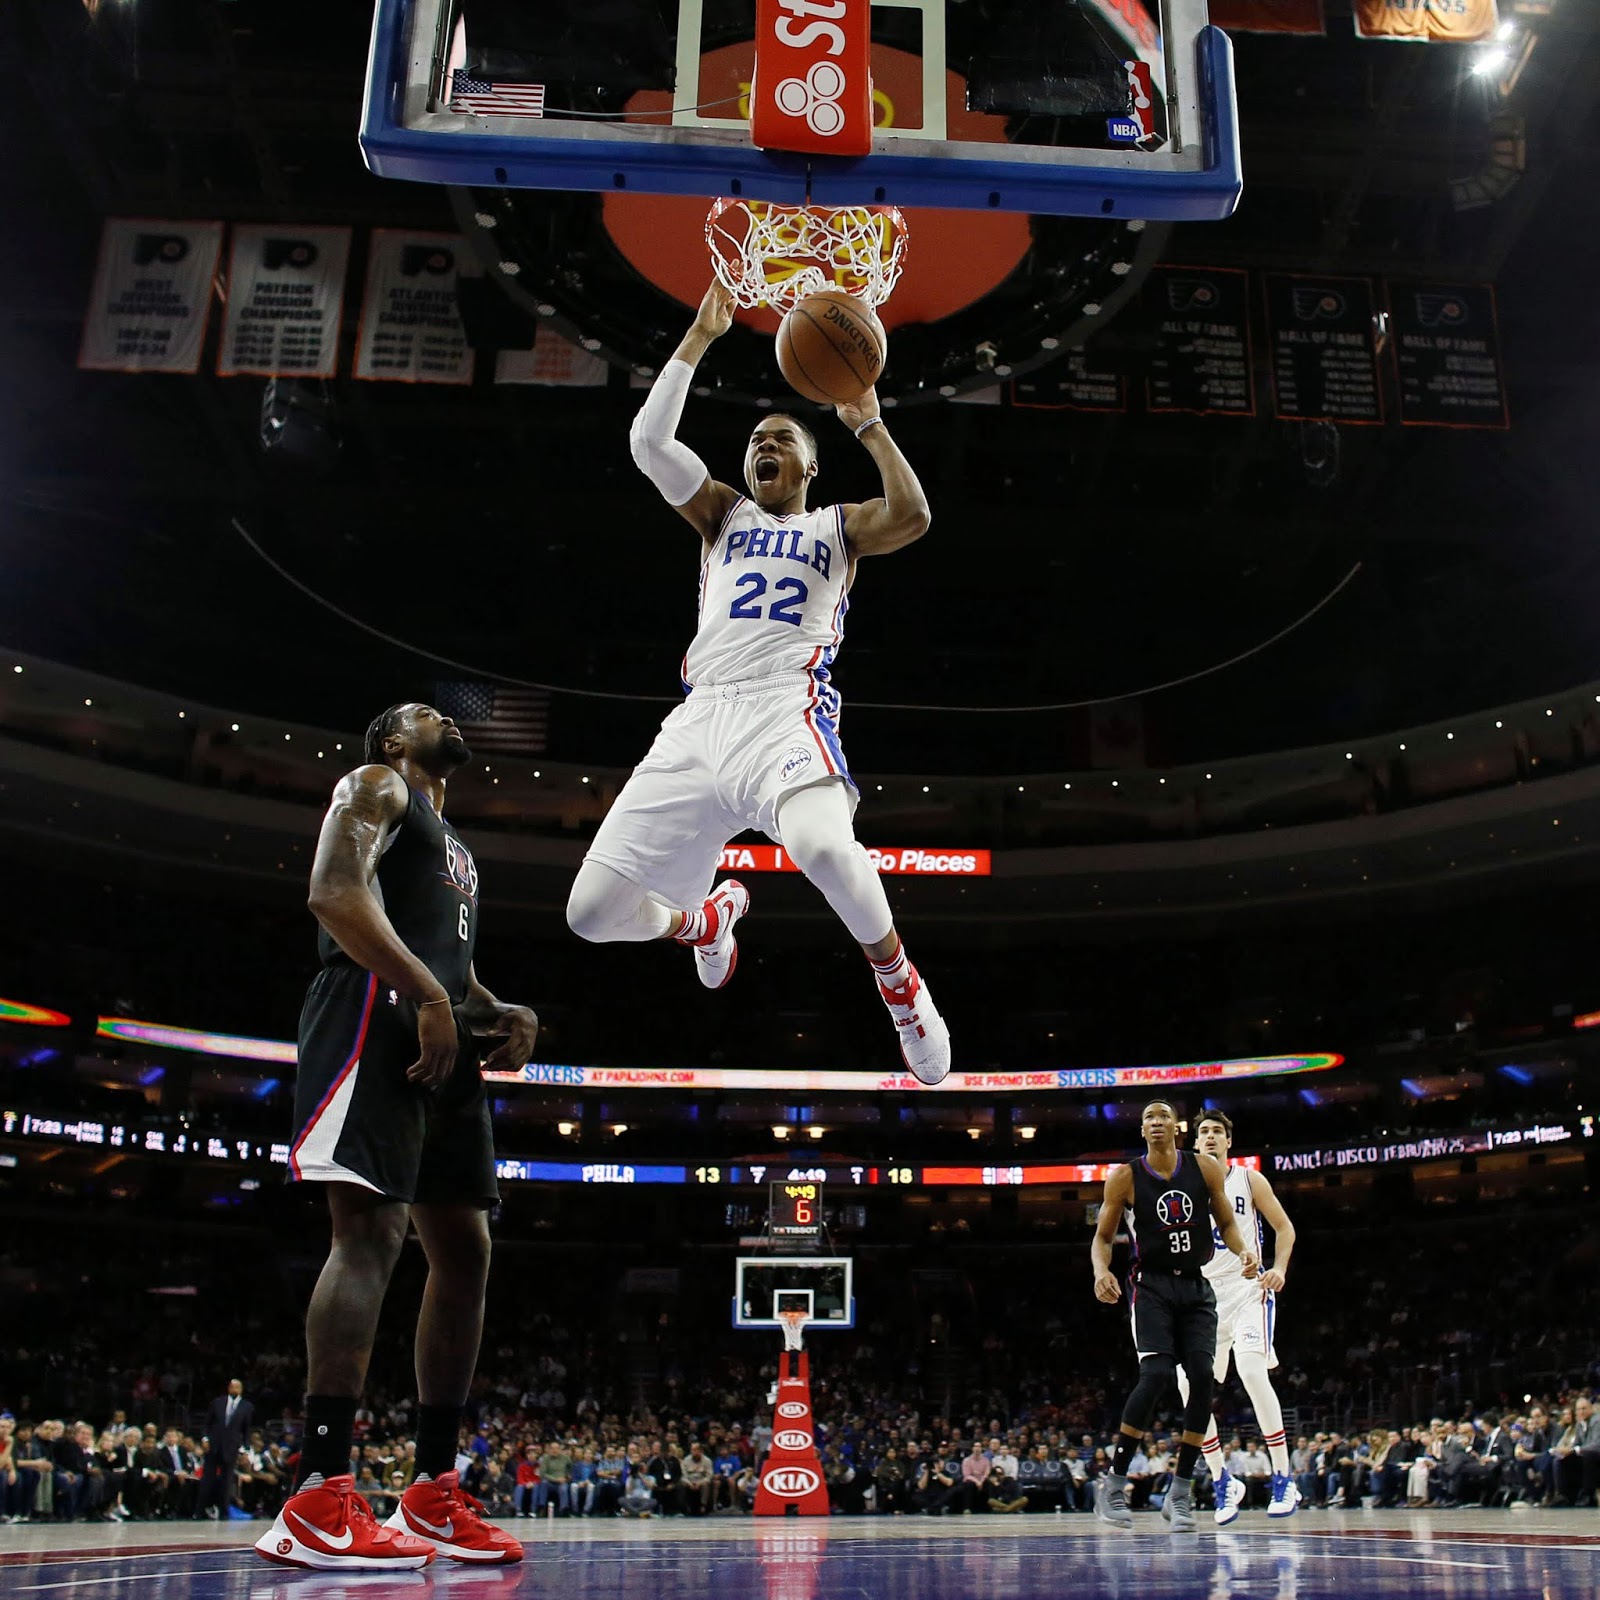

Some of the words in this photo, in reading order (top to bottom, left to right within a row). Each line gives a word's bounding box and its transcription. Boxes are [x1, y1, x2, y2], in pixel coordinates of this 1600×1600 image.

[1113, 124, 1139, 137] NBA
[256, 282, 314, 294] PATRICK
[253, 296, 313, 307] DIVISION
[107, 303, 189, 317] CHAMPIONS
[240, 307, 322, 320] CHAMPIONS
[380, 311, 459, 328] CHAMPIONS
[823, 304, 880, 373] SPALDING
[1278, 330, 1311, 343] HALL
[722, 528, 832, 582] PHILA
[730, 573, 808, 627] 22
[866, 849, 896, 871] Go
[899, 850, 976, 872] Places
[458, 902, 468, 941] 6
[525, 1064, 584, 1084] SIXERS
[592, 1073, 603, 1082] AT
[965, 1076, 982, 1086] USE
[987, 1075, 1023, 1086] PROMO
[1026, 1074, 1053, 1085] CODE
[1058, 1069, 1116, 1087] SIXERS
[1121, 1071, 1133, 1082] AT
[1494, 1131, 1521, 1145] 7:23
[1274, 1150, 1321, 1171] PANIC!
[1337, 1147, 1377, 1166] DISCO
[582, 1164, 635, 1182] PHILA
[695, 1167, 721, 1183] 13
[752, 1173, 762, 1184] 7
[787, 1168, 826, 1182] 4:49
[852, 1173, 861, 1184] 1
[888, 1168, 914, 1184] 18
[1082, 1170, 1093, 1182] 2
[785, 1185, 816, 1199] 4:49
[796, 1200, 810, 1223] 6
[785, 1226, 818, 1235] TISSOT
[1169, 1230, 1191, 1253] 33
[780, 1434, 806, 1446] KIA
[773, 1474, 811, 1490] KIA
